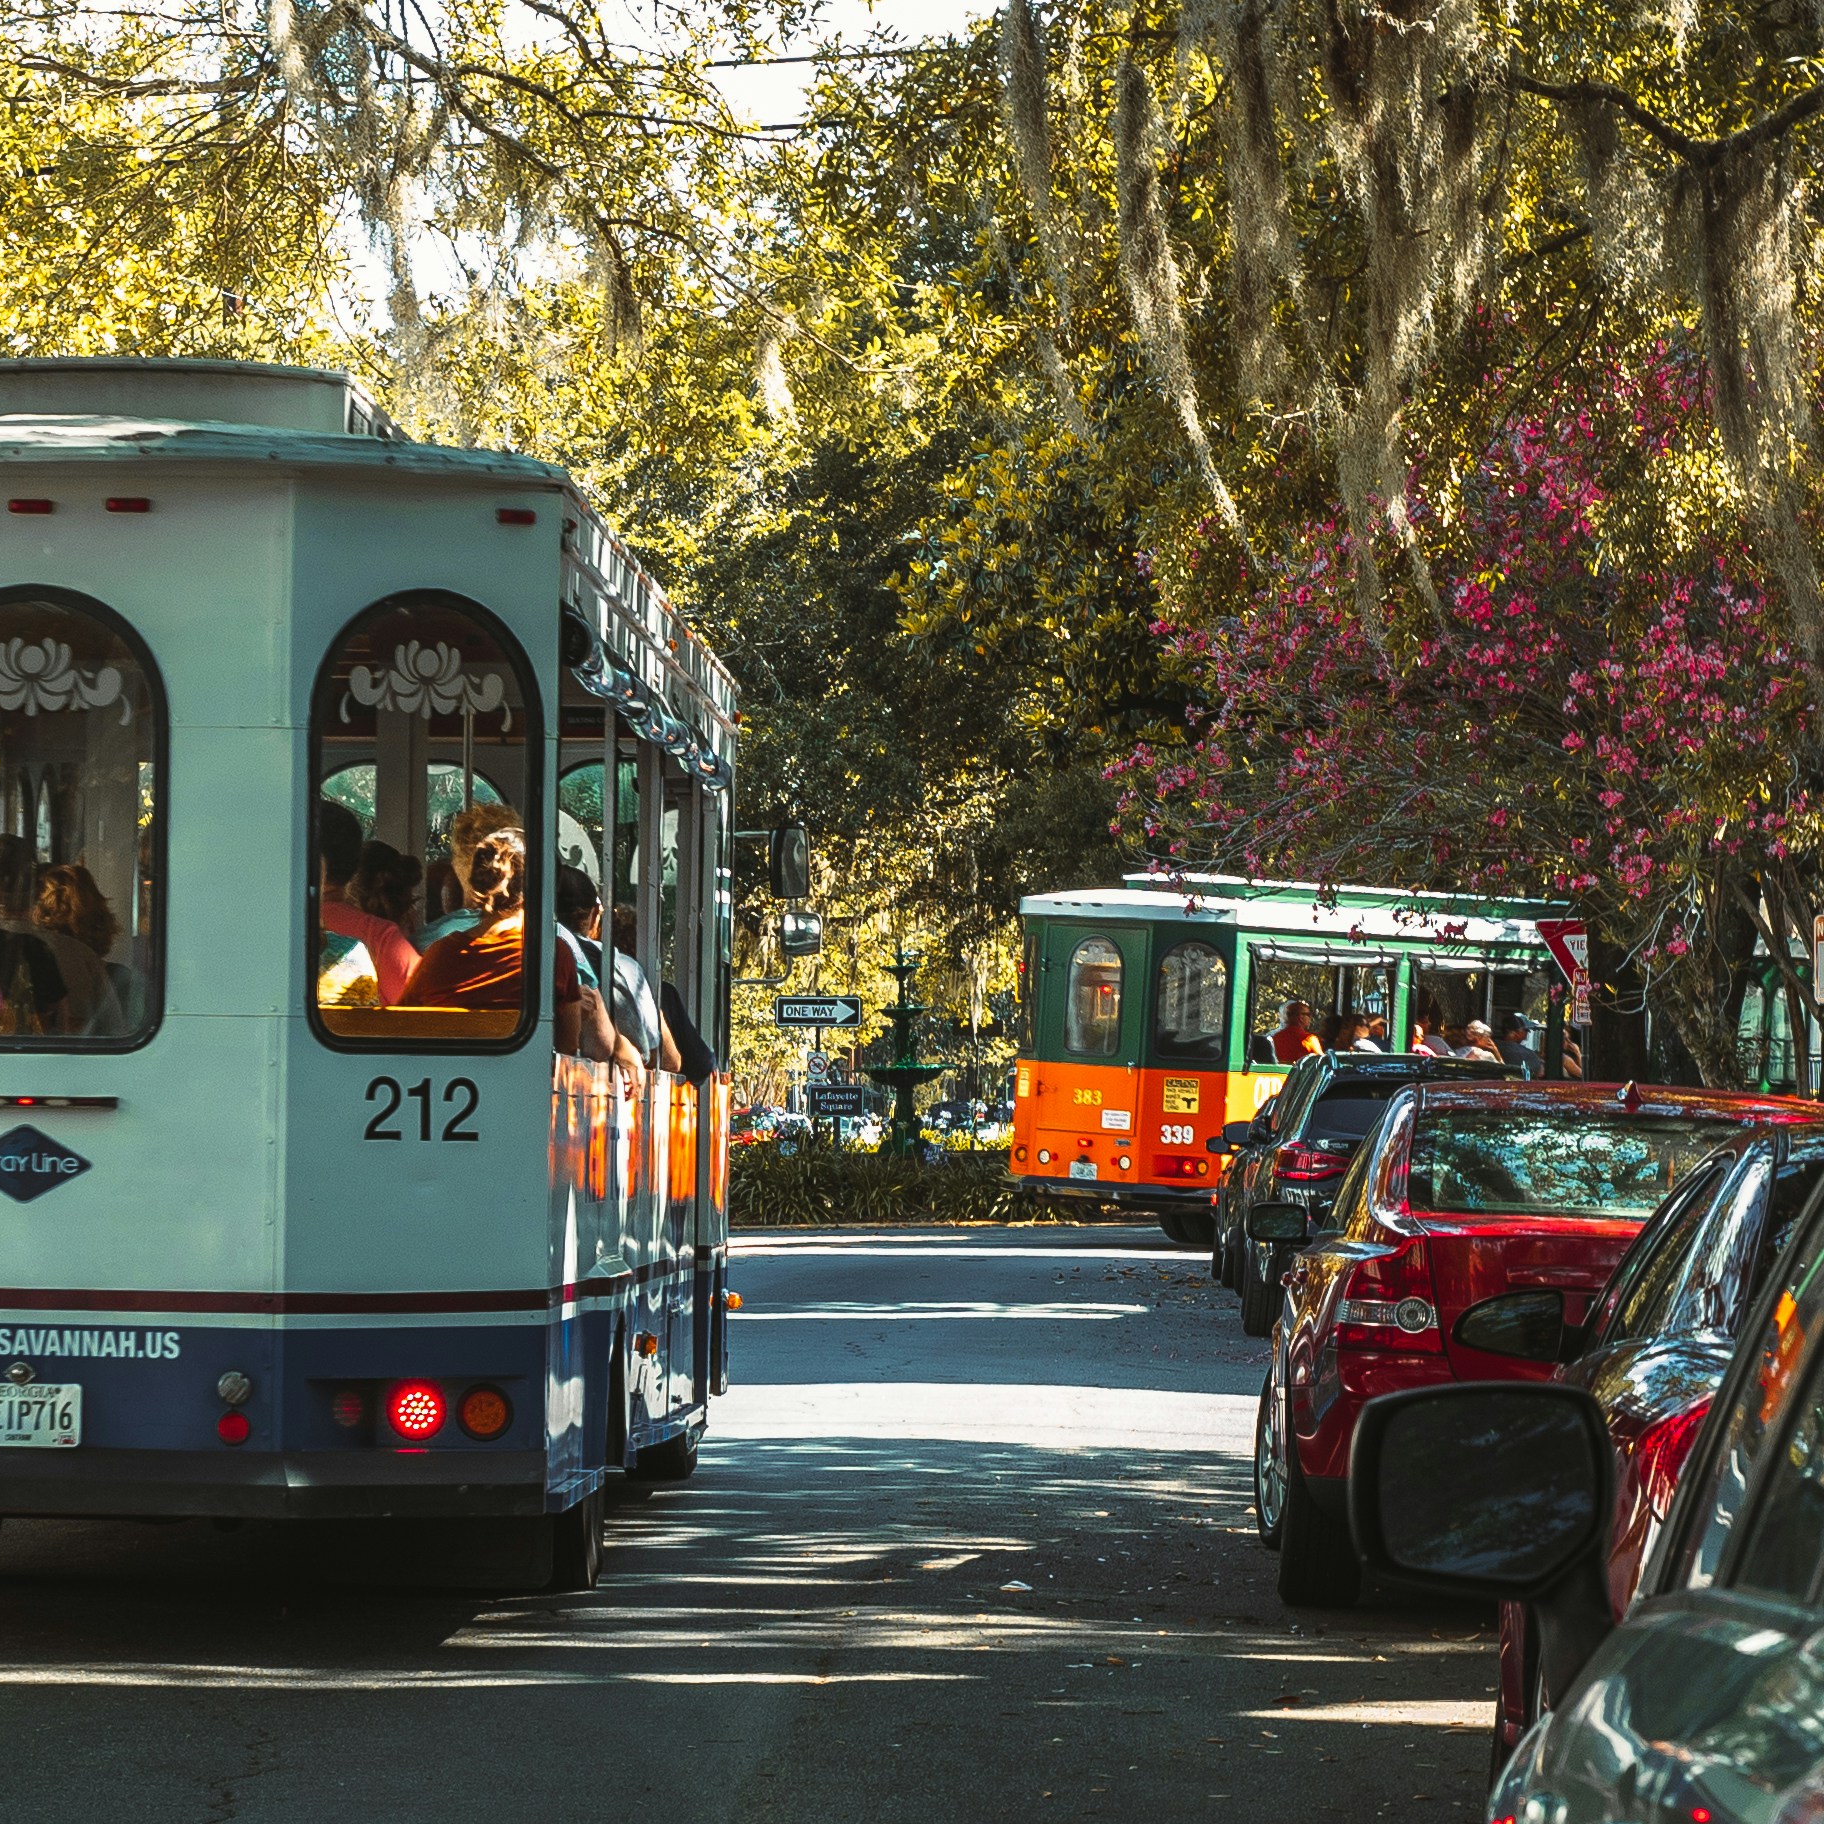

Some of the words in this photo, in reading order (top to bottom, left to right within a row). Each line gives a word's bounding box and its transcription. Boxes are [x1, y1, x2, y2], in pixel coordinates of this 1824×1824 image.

[1569, 940, 1586, 951] YIE
[785, 1006, 809, 1017] ONE
[811, 1006, 835, 1017] WAY
[815, 1092, 858, 1102] Lafayette
[1073, 1088, 1103, 1106] 383
[363, 1075, 480, 1142] 212
[820, 1102, 853, 1112] Square
[1160, 1124, 1194, 1145] 339
